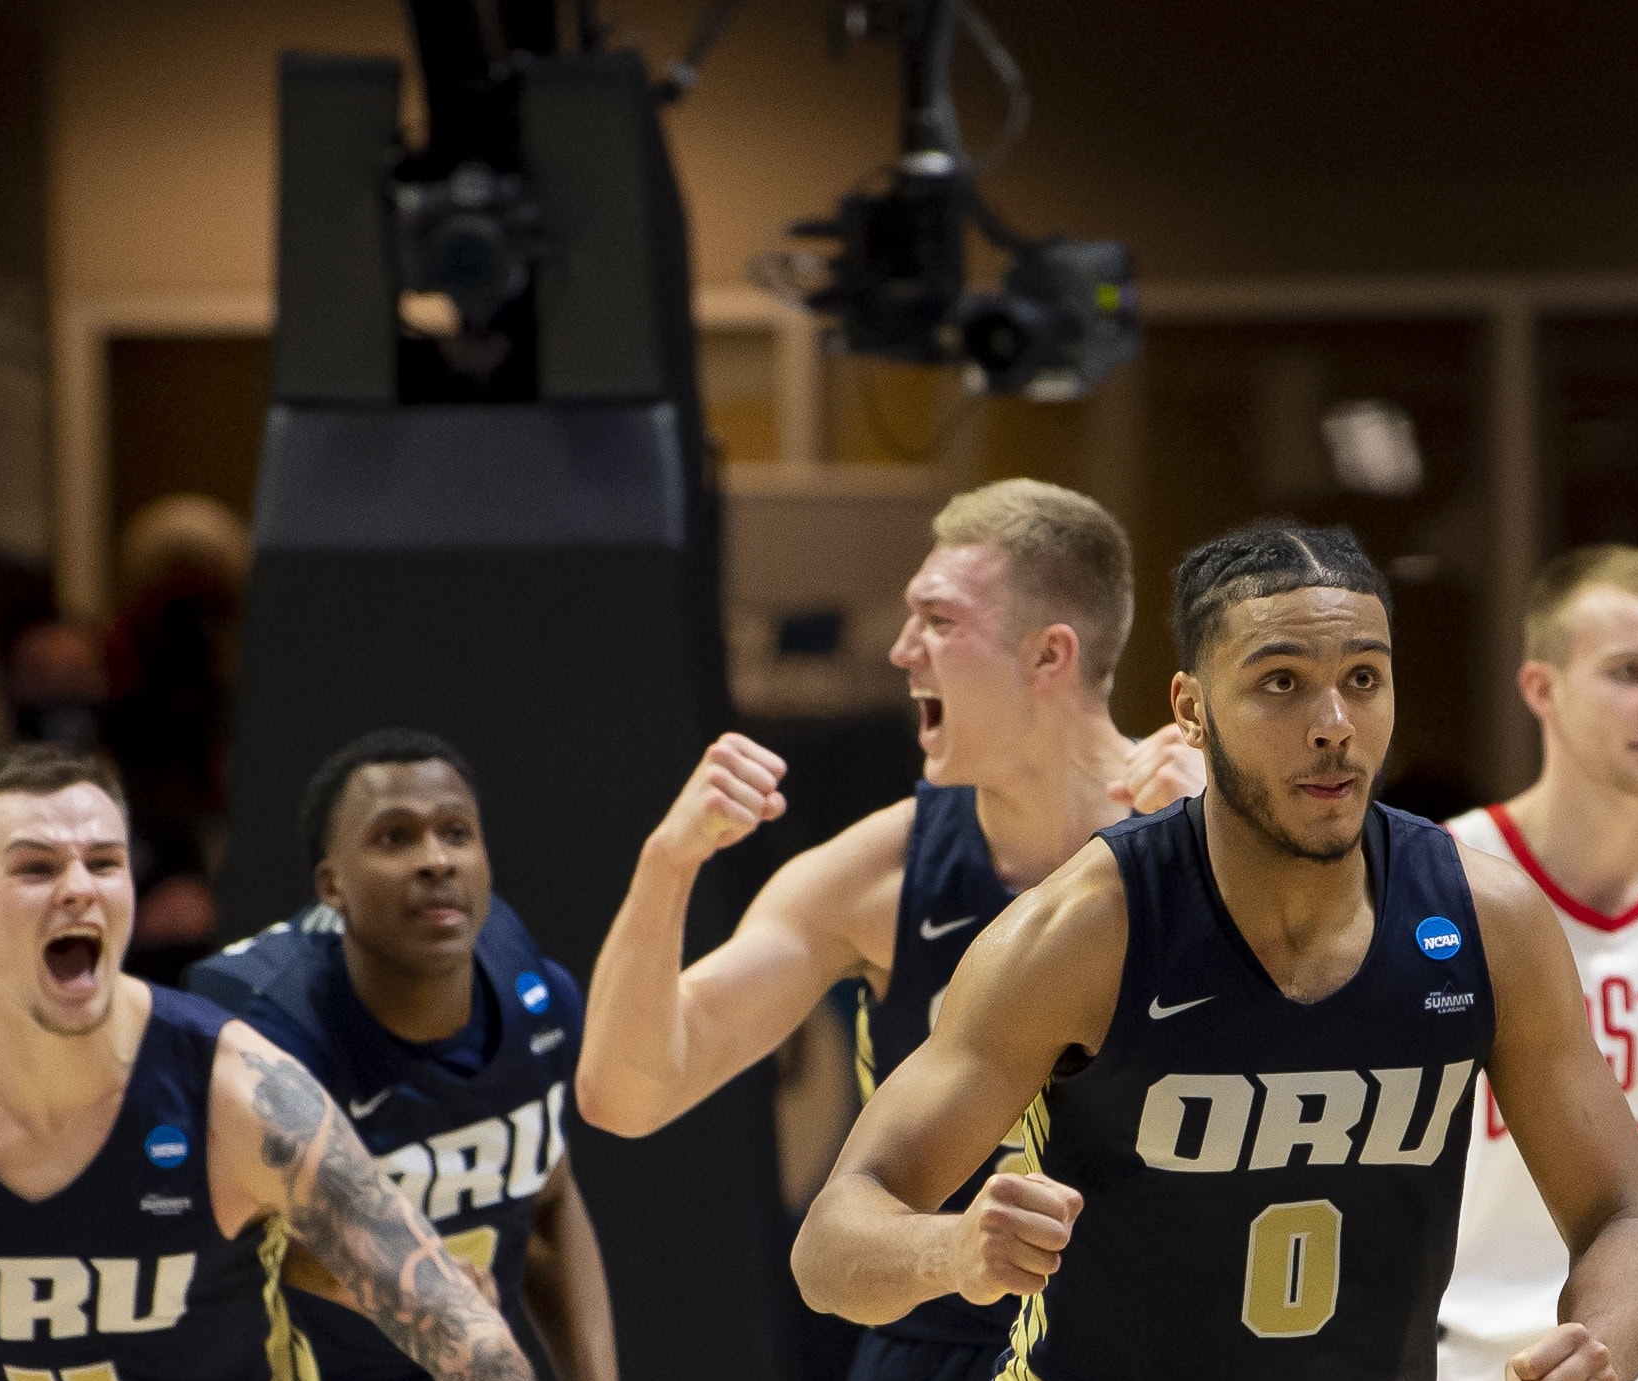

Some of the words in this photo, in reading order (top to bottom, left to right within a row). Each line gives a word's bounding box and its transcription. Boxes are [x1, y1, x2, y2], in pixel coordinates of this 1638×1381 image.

[1423, 933, 1460, 951] NCAA
[1424, 993, 1475, 1010] SUMMIT
[1135, 1058, 1475, 1174] ORU
[1241, 1199, 1343, 1338] 0
